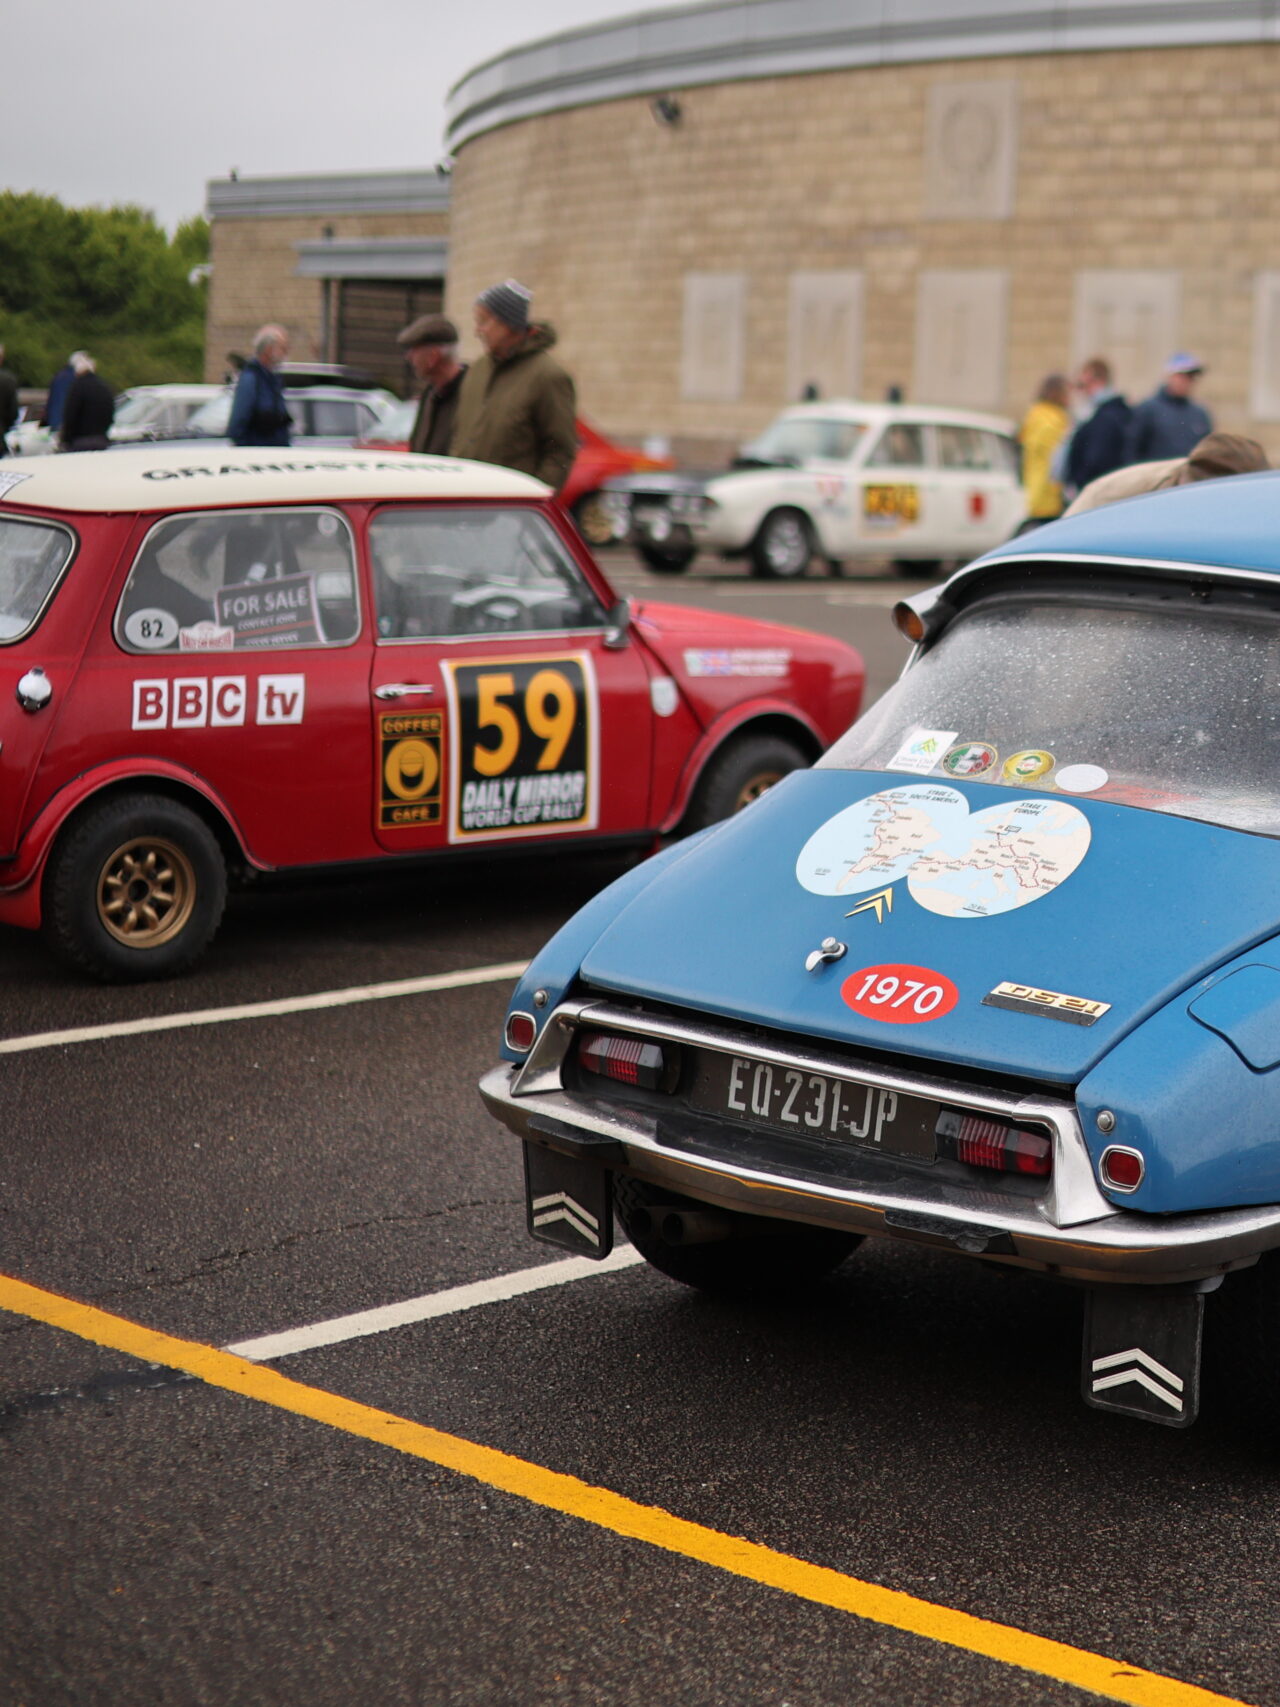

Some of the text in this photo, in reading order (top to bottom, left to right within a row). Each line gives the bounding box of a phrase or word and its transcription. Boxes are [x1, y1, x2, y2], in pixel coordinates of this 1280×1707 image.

[222, 586, 308, 619] FOR SALE
[140, 618, 164, 639] 82
[137, 683, 299, 722] BBC tv
[383, 716, 440, 733] COFFEE
[473, 668, 578, 777] 59
[462, 771, 586, 813] DAILY MIRROR
[462, 800, 585, 830] WORLD CUP RALLY
[854, 974, 944, 1015] 1970
[727, 1057, 899, 1143] EQ-231-JP
